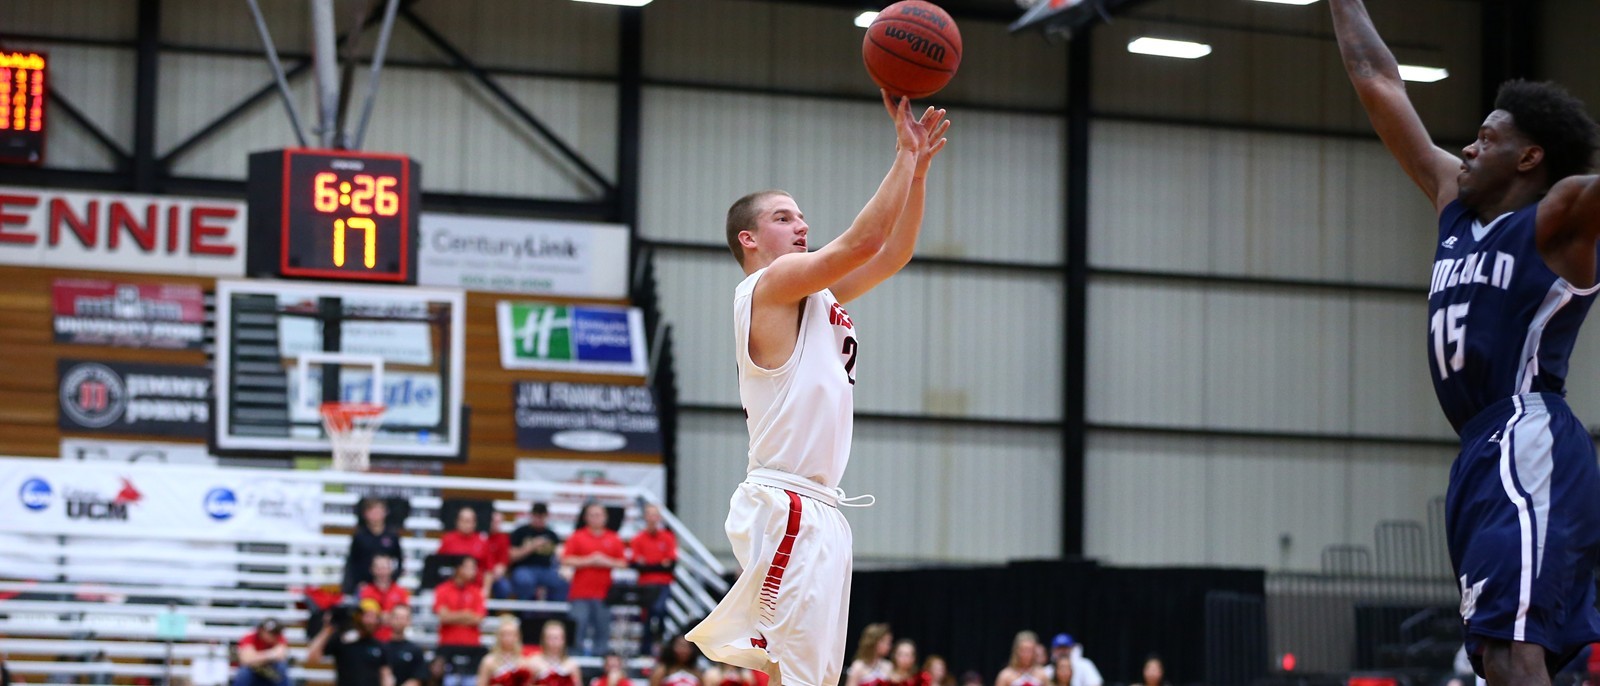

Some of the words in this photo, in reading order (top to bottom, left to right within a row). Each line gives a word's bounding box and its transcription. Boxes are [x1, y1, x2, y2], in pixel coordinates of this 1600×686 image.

[885, 25, 946, 64] Wilson
[314, 172, 399, 217] 6:26
[333, 217, 376, 269] 17
[431, 228, 578, 261] CenturyLink
[1430, 301, 1470, 381] 15
[126, 374, 209, 400] JIMMY
[550, 383, 624, 411] FRANKLIN
[126, 400, 209, 424] JOHN'S
[516, 407, 585, 428] Commercial
[65, 499, 129, 521] UCM
